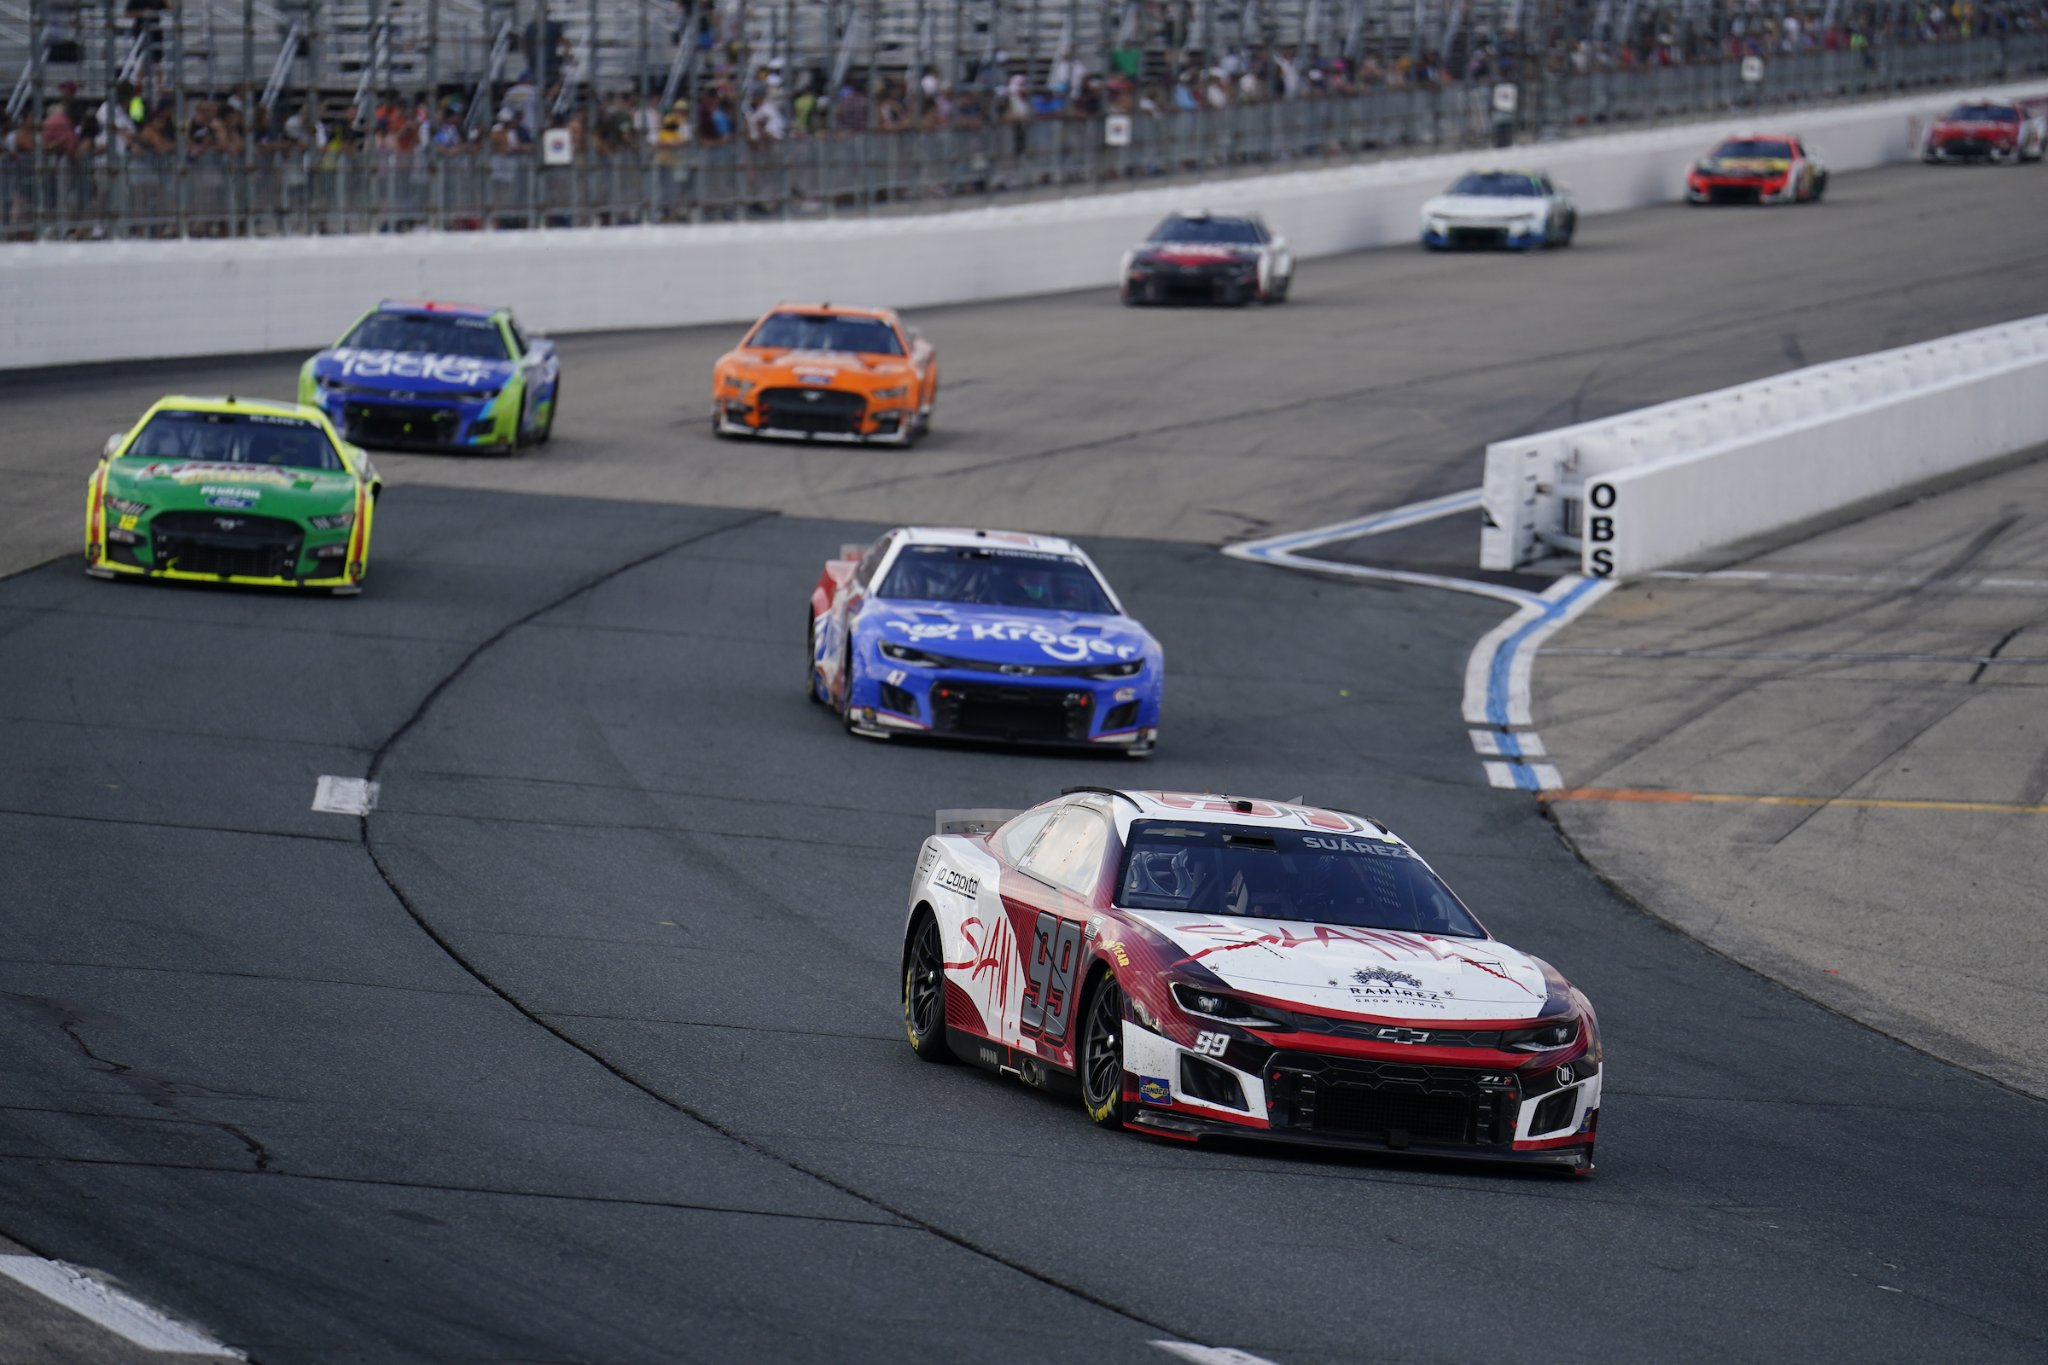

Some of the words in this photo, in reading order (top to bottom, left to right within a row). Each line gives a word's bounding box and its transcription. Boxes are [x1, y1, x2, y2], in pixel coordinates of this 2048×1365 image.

[1589, 482, 1617, 578] OBS
[971, 621, 1136, 662] Kroger
[1302, 836, 1408, 859] SUÁREZ
[1020, 910, 1082, 1048] 99
[1349, 987, 1441, 1001] RAMIREZ
[1395, 999, 1425, 1007] WITH
[1193, 1030, 1231, 1058] 99
[1141, 1084, 1169, 1097] SUNOCO
